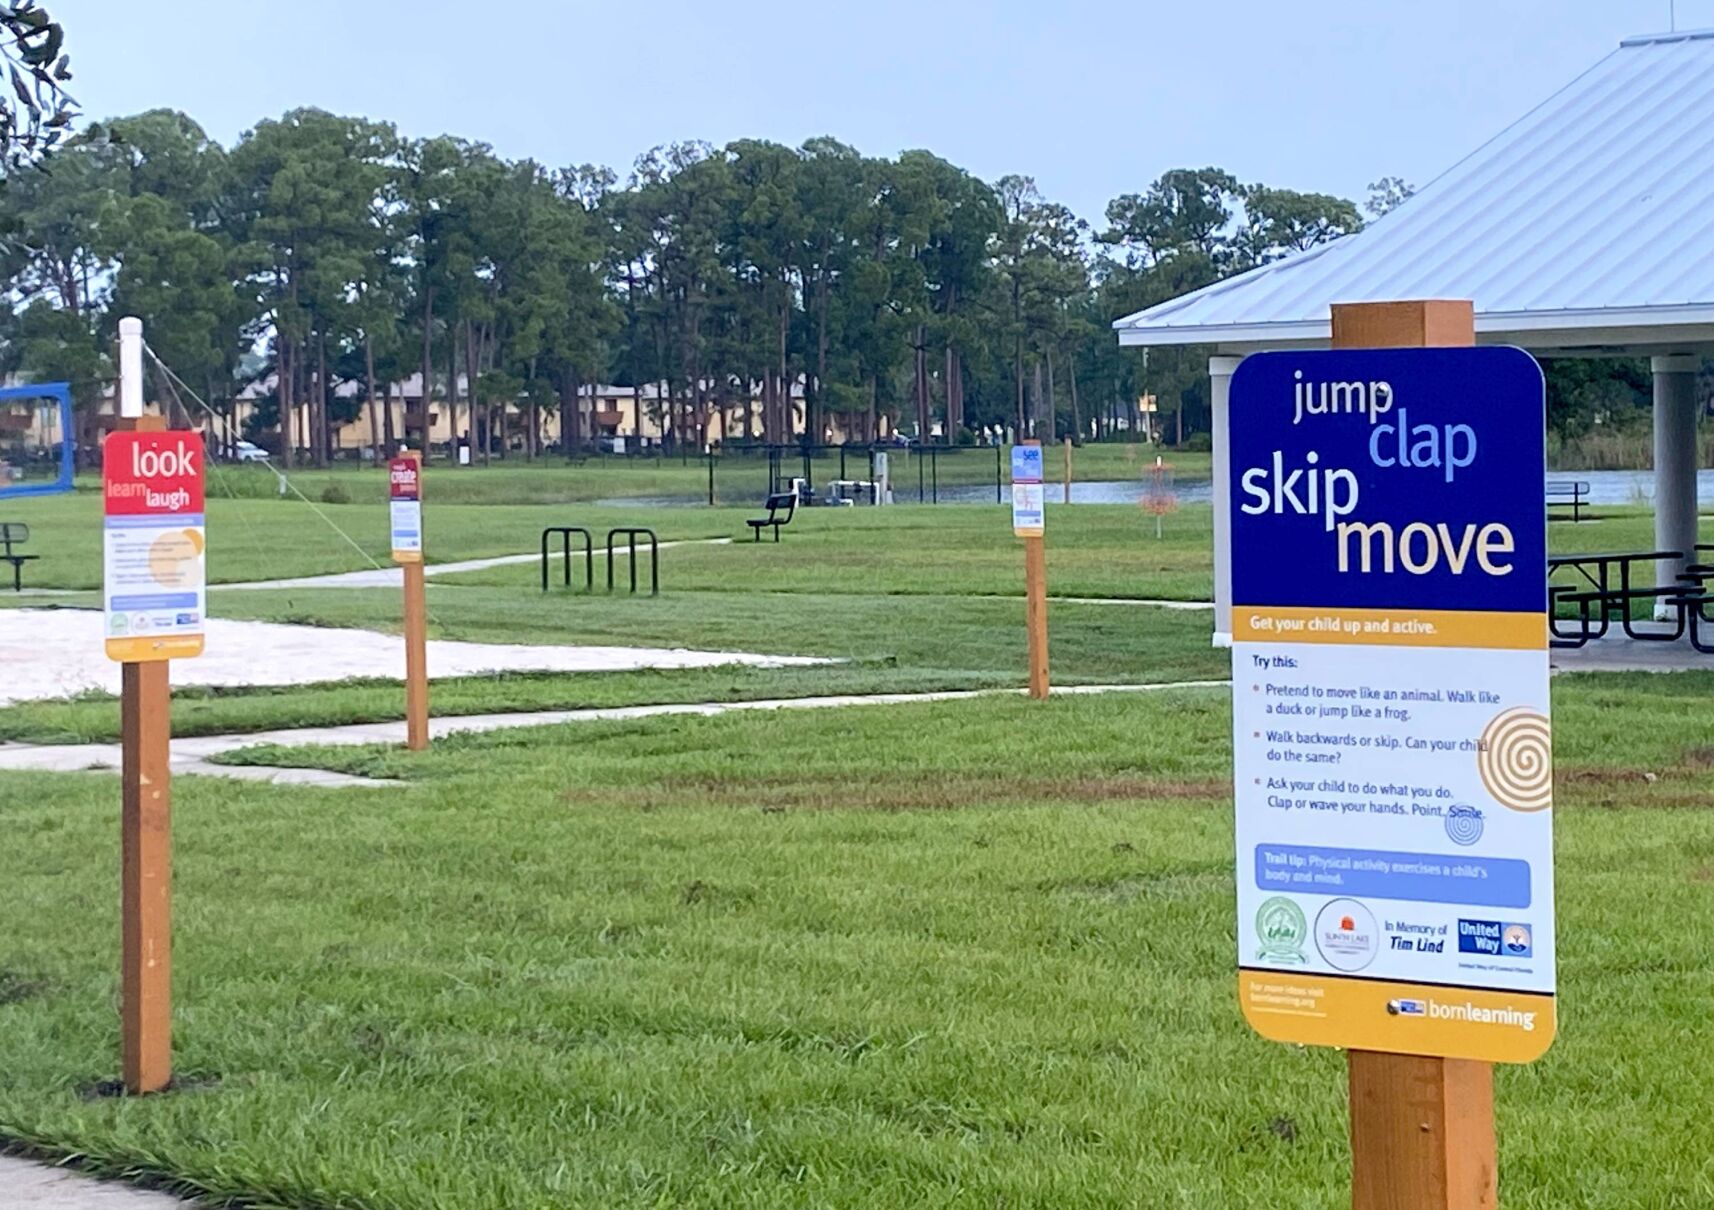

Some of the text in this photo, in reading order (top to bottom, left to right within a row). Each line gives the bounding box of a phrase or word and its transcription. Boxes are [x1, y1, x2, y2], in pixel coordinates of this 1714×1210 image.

[1293, 369, 1393, 424] jump
[1369, 408, 1477, 482] clap
[132, 441, 196, 477] look
[107, 479, 146, 497] learn
[1241, 450, 1359, 531] skip
[146, 488, 190, 510] laugh
[1337, 521, 1515, 575] move
[1250, 615, 1438, 635] Get your child up and active.
[1252, 654, 1298, 670] Try this:
[1266, 683, 1501, 704] Pretend to move like an animal. Walk like
[1266, 702, 1412, 722] a duck or jump like a frog.
[1266, 730, 1489, 752] Walk backwards or skip. Can your child
[1267, 748, 1342, 764] do the same?
[1267, 777, 1454, 799] Ask your child to do what you do.
[1267, 795, 1293, 811] Clap
[1295, 800, 1307, 809] or
[1309, 800, 1338, 811] wave
[1341, 802, 1367, 814] your
[1369, 801, 1409, 815] hands.
[1412, 803, 1447, 817] Point.
[1264, 852, 1287, 865] Trail
[1308, 855, 1351, 870] Physical
[1353, 858, 1390, 874] activity
[1392, 862, 1441, 876] exercises
[1443, 866, 1450, 876] a
[1452, 864, 1488, 879] child's
[1265, 868, 1291, 883] body
[1293, 871, 1313, 882] and
[1385, 920, 1448, 936] In Memory of
[1460, 921, 1500, 937] United
[1390, 936, 1445, 953] Tim Lind
[1474, 936, 1500, 954] Way
[1429, 999, 1536, 1031] bornlearning
